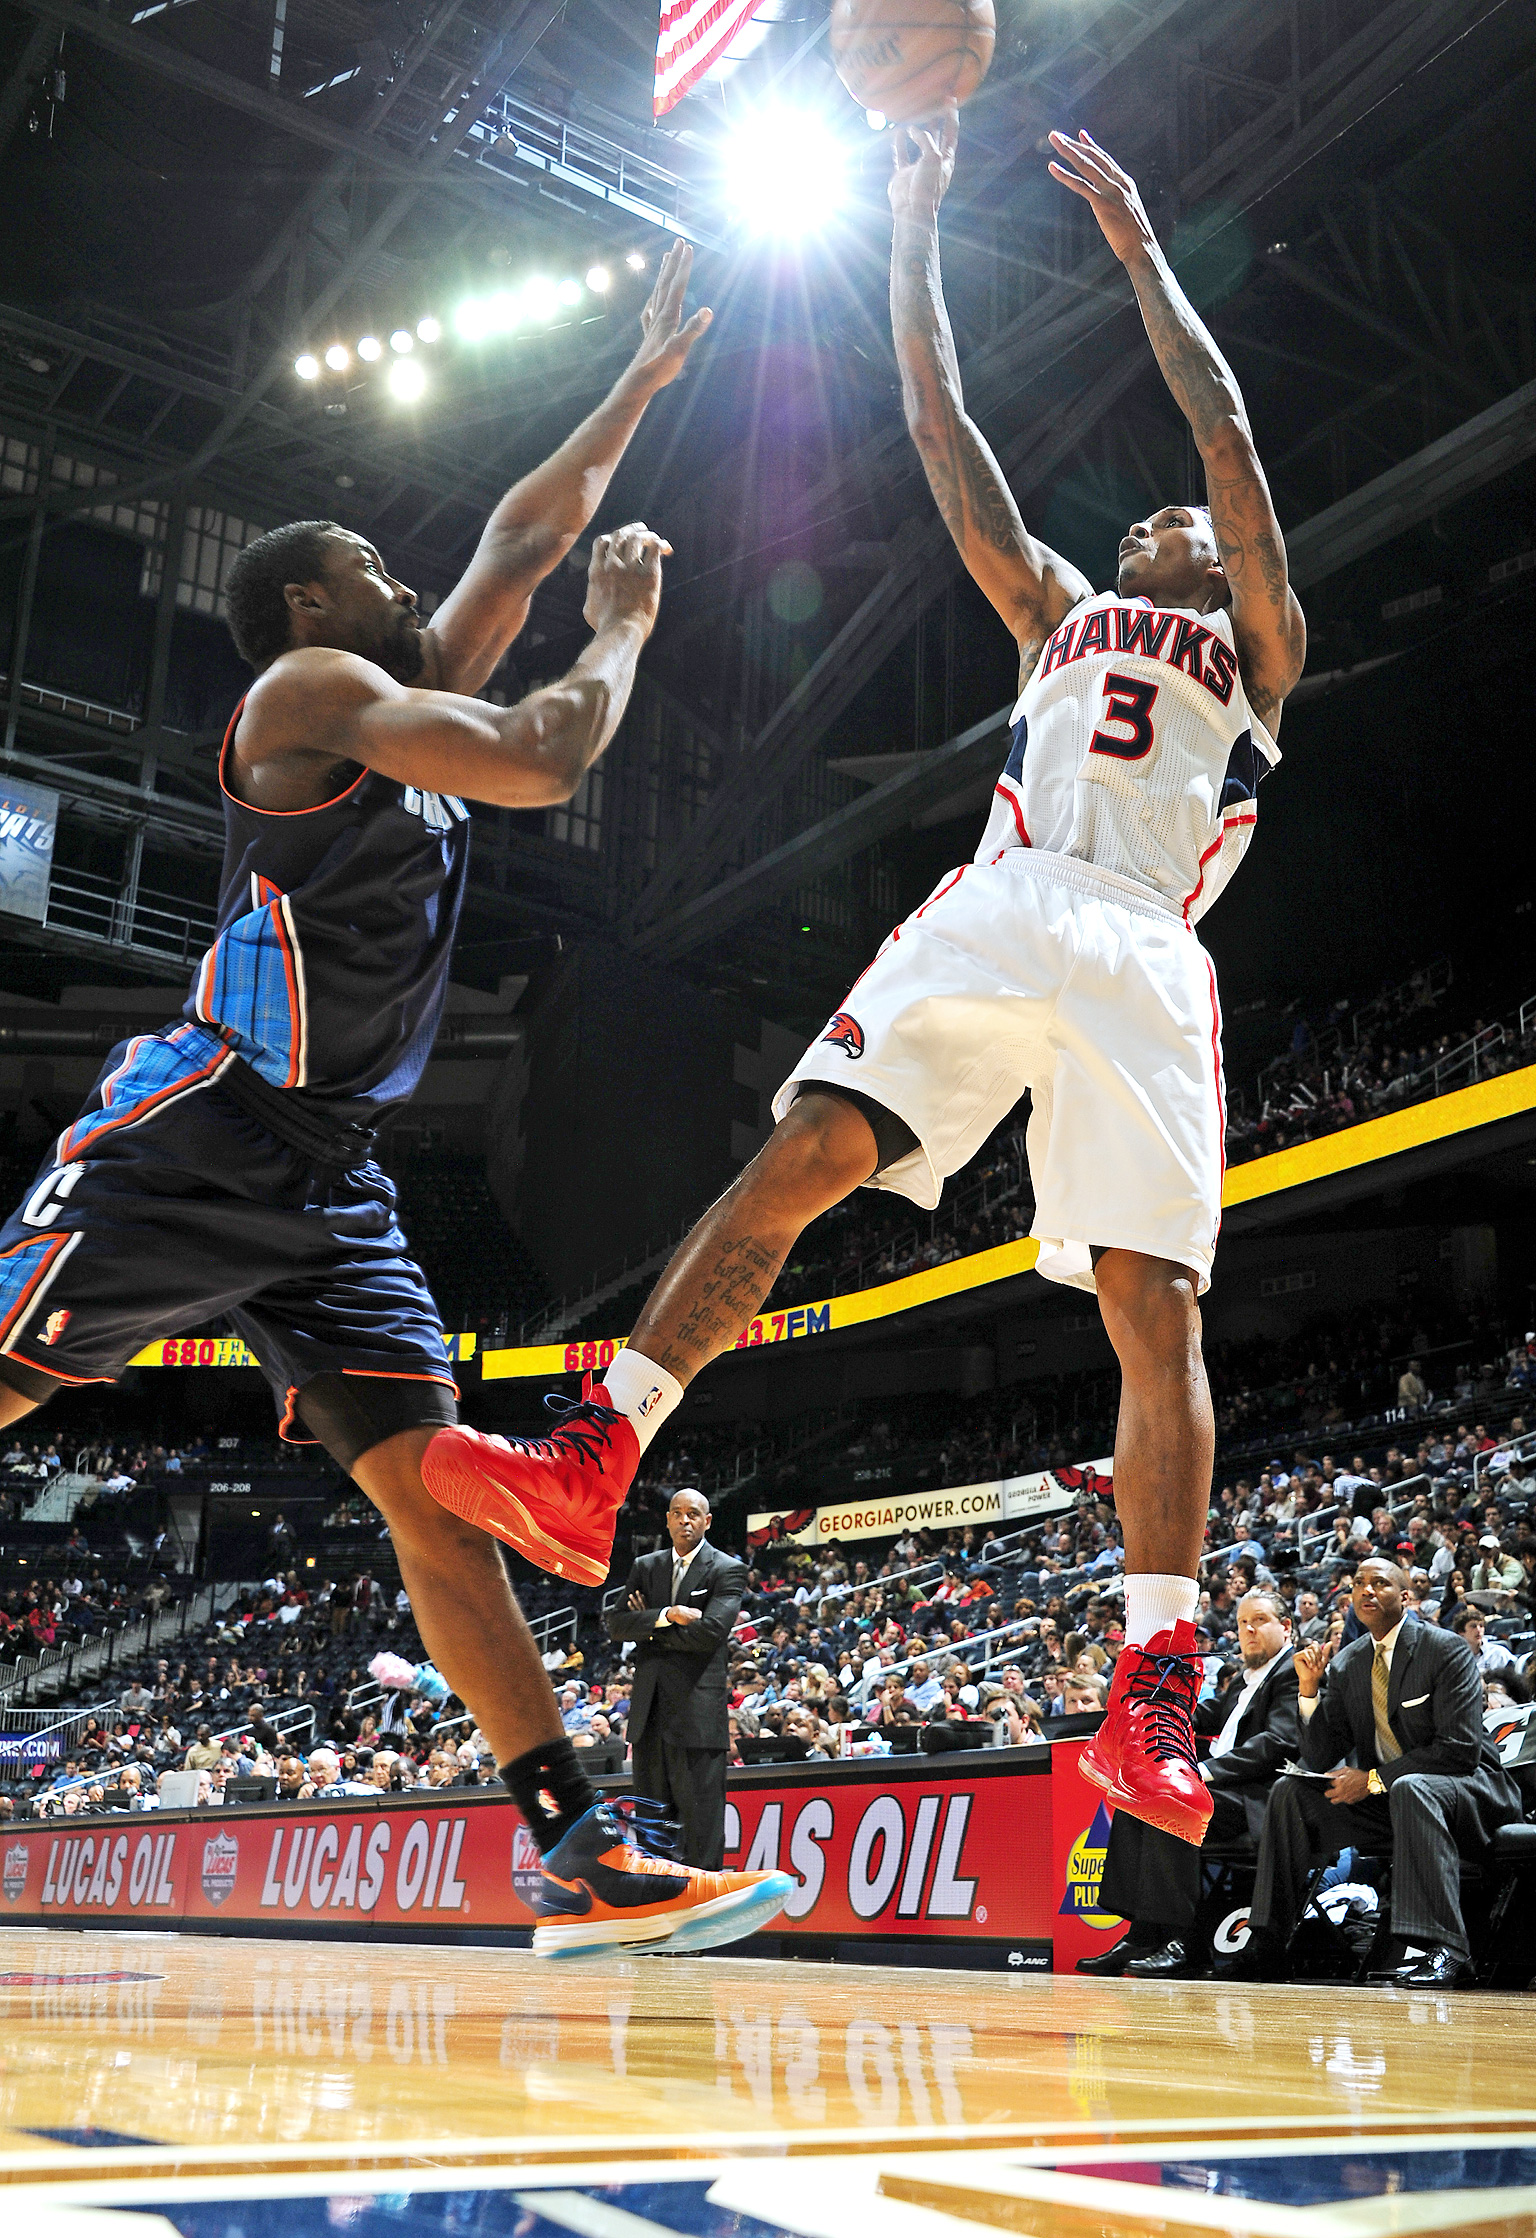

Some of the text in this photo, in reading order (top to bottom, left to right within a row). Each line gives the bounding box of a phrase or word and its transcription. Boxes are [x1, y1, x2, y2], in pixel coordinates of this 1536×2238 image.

[1039, 608, 1238, 707] HAWKS
[1089, 672, 1159, 761] 3
[162, 1339, 215, 1366] 680
[564, 1340, 614, 1372] 680
[1385, 1407, 1406, 1424] 114
[219, 1437, 240, 1449] 207
[209, 1482, 252, 1494] 206-208
[819, 1492, 1001, 1534] GEORGIAPOWER.COM
[41, 1832, 177, 1908] LUCAS OIL
[260, 1817, 467, 1913] LUCAS OIL
[848, 1793, 980, 1923] OIL
[1072, 1852, 1105, 1880] Supe
